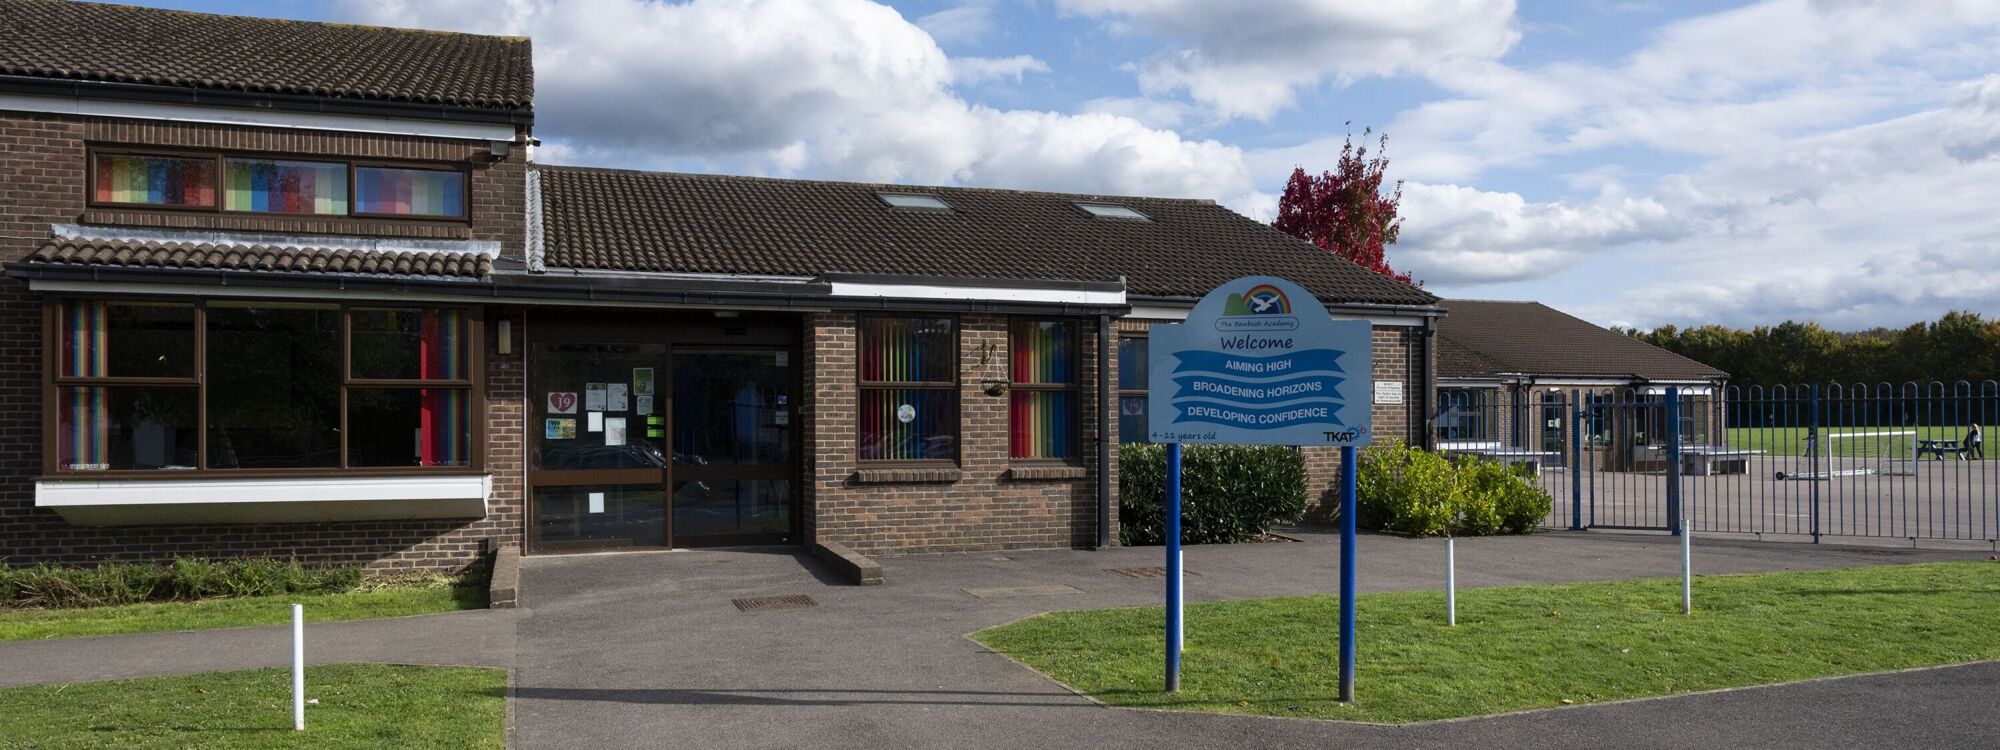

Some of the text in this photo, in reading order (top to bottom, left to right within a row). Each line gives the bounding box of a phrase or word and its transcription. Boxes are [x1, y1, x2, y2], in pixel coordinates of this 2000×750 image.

[1220, 320, 1232, 328] The
[1264, 318, 1294, 328] Academy
[1220, 334, 1293, 350] Welcome
[1225, 360, 1292, 373] AIMING HIGH
[1193, 381, 1322, 398] BROADENING HORIZONS
[1188, 406, 1328, 424] DEVELOPING CONFIDENCE
[1178, 432, 1201, 441] years
[1203, 431, 1216, 440] old
[1323, 432, 1354, 442] TKAT
